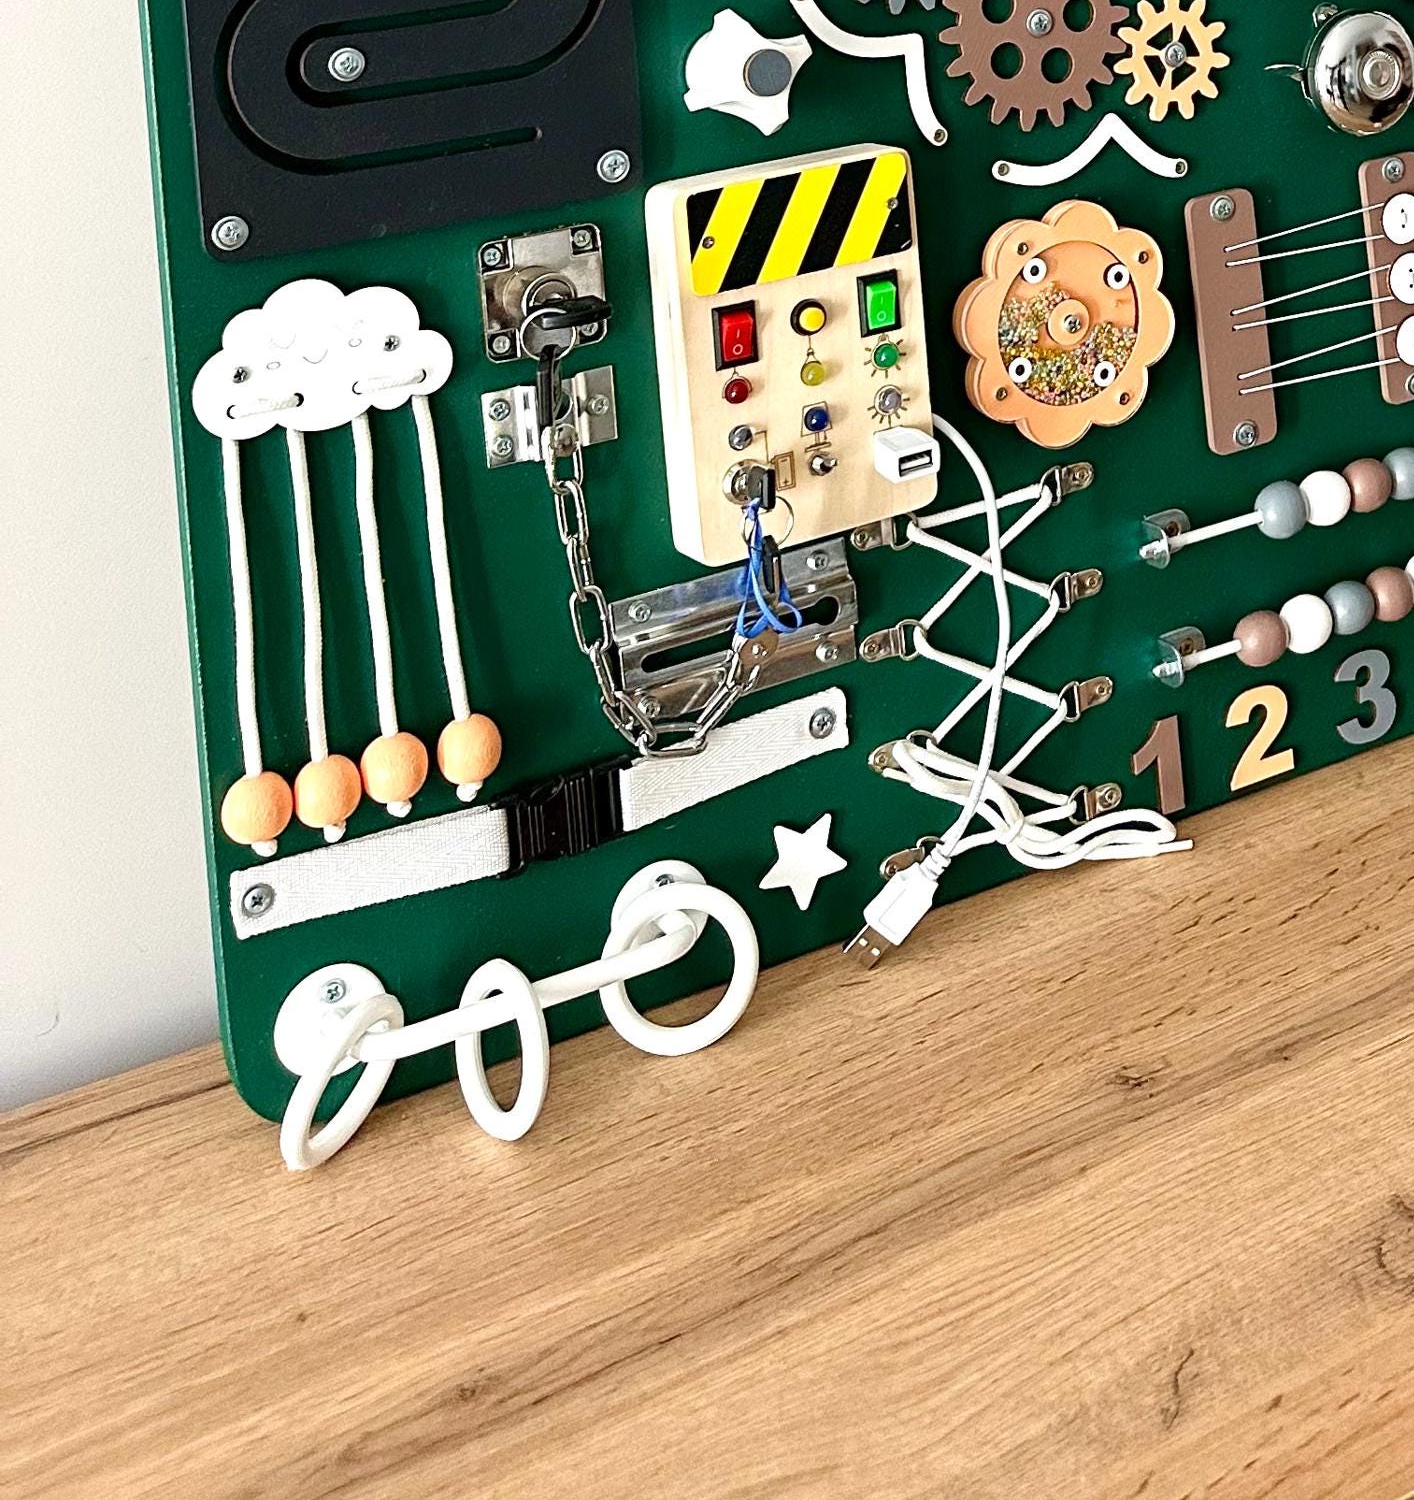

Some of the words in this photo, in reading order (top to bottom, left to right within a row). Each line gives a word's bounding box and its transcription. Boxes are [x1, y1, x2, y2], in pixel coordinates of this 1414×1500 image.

[1132, 715, 1186, 815] 1
[1225, 685, 1295, 791] 2
[1334, 649, 1397, 744] 3
